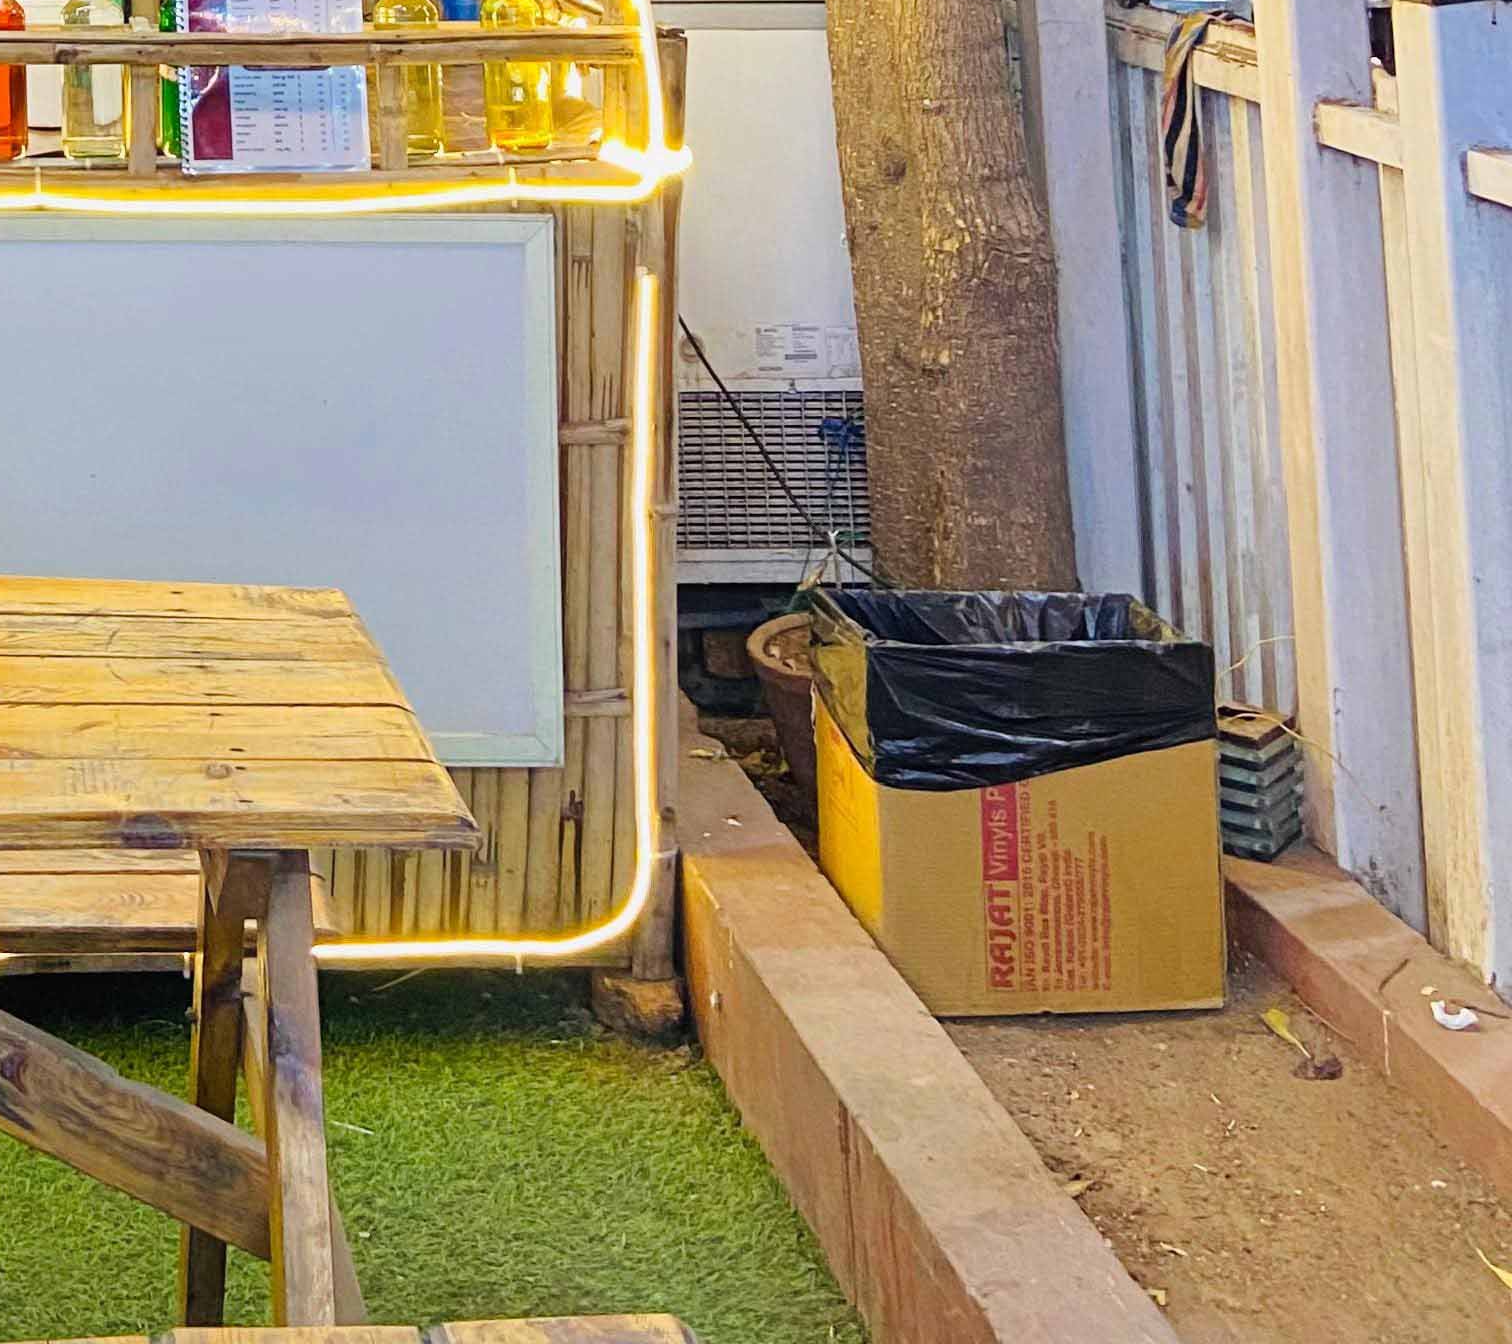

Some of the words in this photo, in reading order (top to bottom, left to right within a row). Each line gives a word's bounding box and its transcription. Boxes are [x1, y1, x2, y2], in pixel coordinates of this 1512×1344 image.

[987, 808, 1011, 876] Vinyls
[1019, 792, 1032, 863] CERTIFIED
[989, 884, 1016, 989] RAJAT
